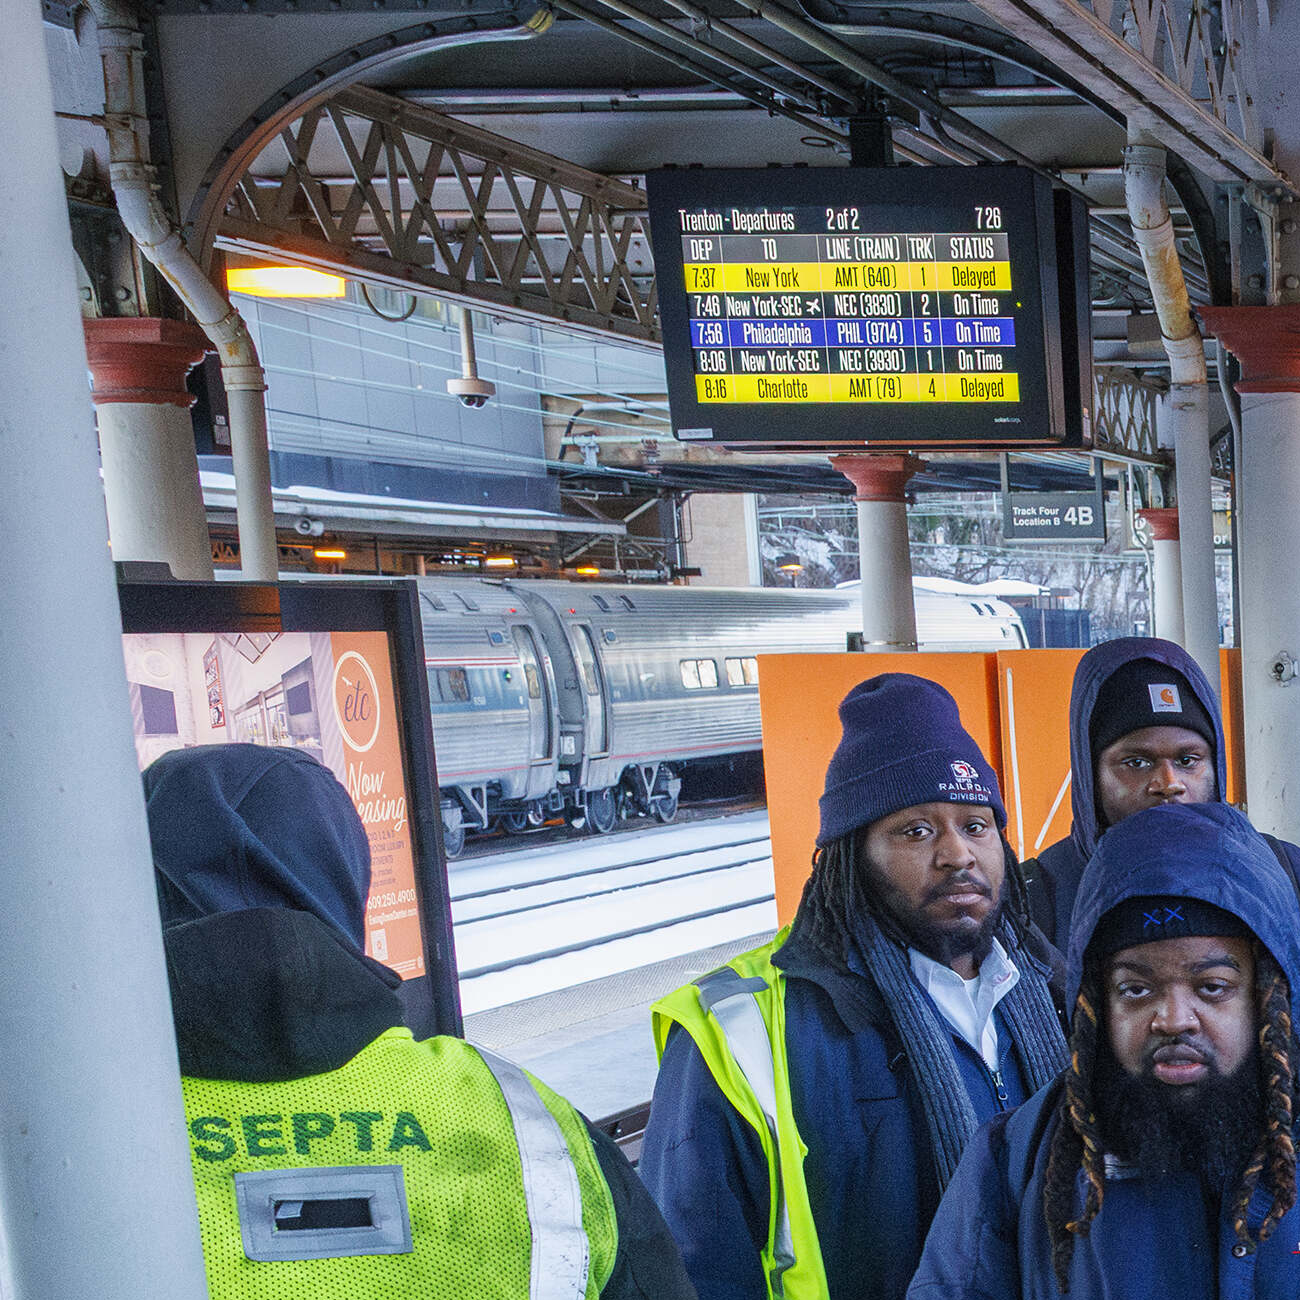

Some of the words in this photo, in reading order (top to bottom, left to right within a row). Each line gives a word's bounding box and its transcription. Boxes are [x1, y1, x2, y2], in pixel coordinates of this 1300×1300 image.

[678, 209, 723, 231] Trenton
[732, 209, 795, 233] Departures
[826, 208, 835, 230] 2
[837, 208, 849, 230] of
[851, 208, 860, 230] 2
[690, 239, 713, 260] DEP
[761, 239, 777, 260] TO
[826, 238, 851, 259] LINE
[854, 236, 900, 261] (TRAIN)
[909, 238, 933, 259] TRK
[950, 237, 994, 259] STATUS
[692, 268, 716, 288] 7:37
[745, 268, 770, 287] New
[773, 267, 799, 287] York
[835, 267, 858, 287] AMT
[862, 265, 897, 288] (640)
[920, 267, 926, 286] 1
[952, 266, 996, 289] Delayed
[694, 295, 720, 316] 7:46
[727, 296, 750, 316] New
[752, 295, 802, 316] York-SEC
[834, 294, 857, 316] NEC
[921, 294, 930, 315] 2
[954, 294, 969, 315] On
[971, 294, 998, 315] Time
[697, 323, 723, 344] 7:56
[743, 322, 812, 346] Philadelphia
[837, 322, 864, 344] PHIL
[866, 320, 904, 344] (9714)
[923, 322, 932, 343] 5
[956, 322, 972, 343] On
[973, 321, 1000, 343] Time
[700, 351, 726, 372] 8:06
[741, 350, 765, 371] New
[767, 350, 820, 371] York-SEC
[839, 350, 862, 371] NEC
[864, 348, 906, 372] (3930)
[927, 350, 933, 370] 1
[958, 350, 973, 370] On
[975, 350, 1003, 370] Time
[704, 378, 727, 398] 8:16
[757, 378, 808, 398] Charlotte
[849, 378, 872, 398] AMT
[876, 376, 902, 399] (79)
[929, 378, 936, 397] 4
[960, 378, 1004, 400] Delayed
[1013, 507, 1036, 515] Track
[1039, 507, 1059, 515] Four
[1013, 517, 1052, 526] Location
[1064, 506, 1094, 525] 4B
[345, 680, 371, 722] etc
[348, 761, 384, 801] Now
[950, 792, 989, 801] DIVISION
[357, 794, 408, 832] easing
[190, 1111, 433, 1162] SEPTA
